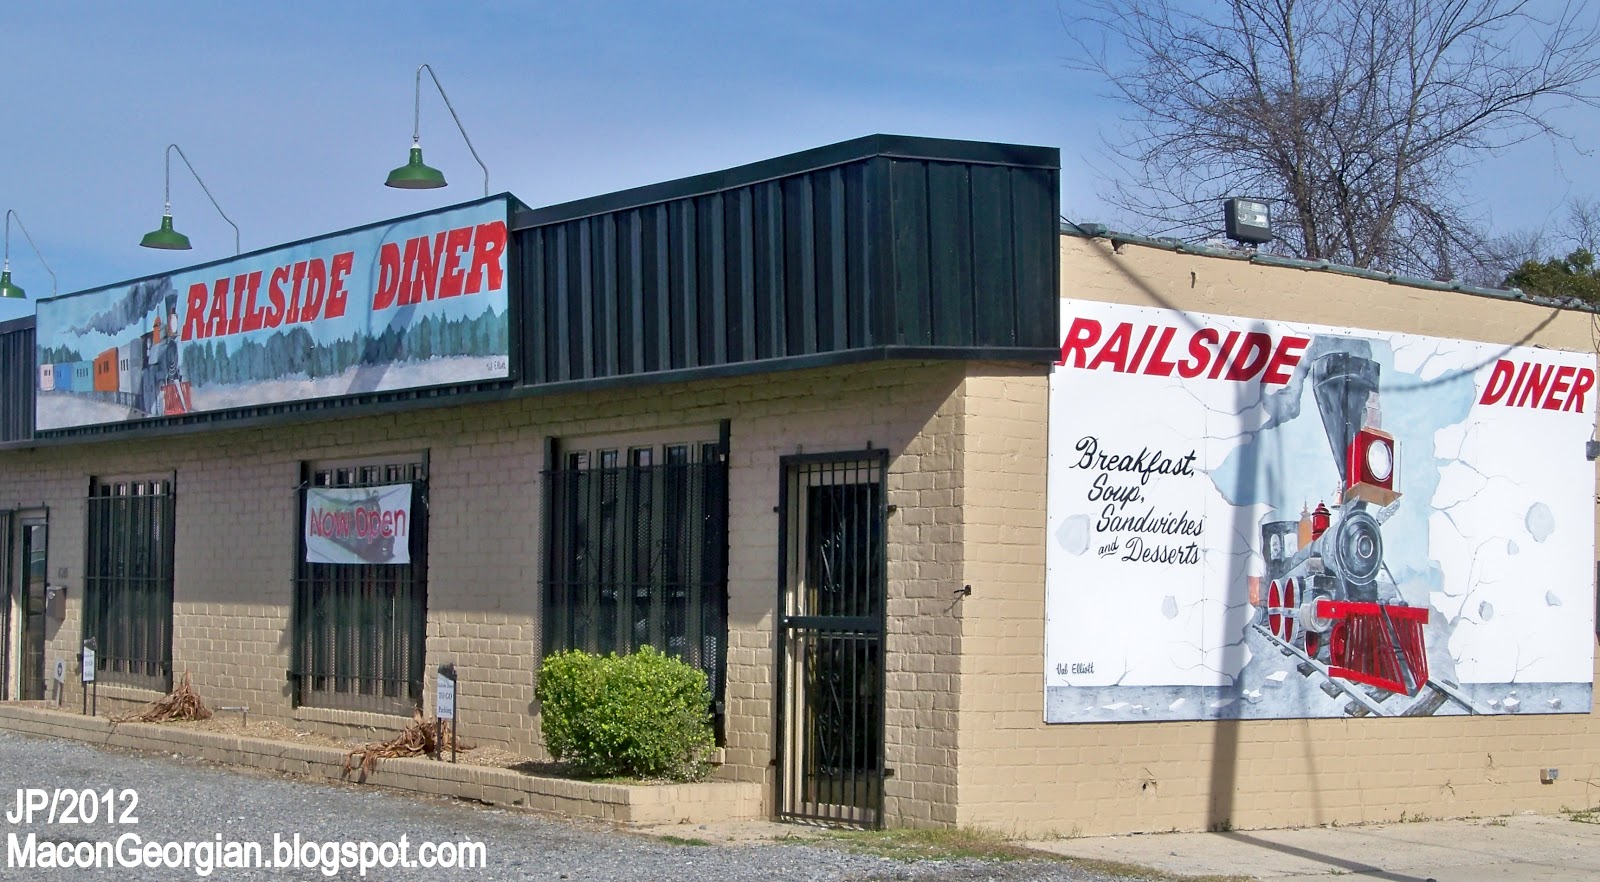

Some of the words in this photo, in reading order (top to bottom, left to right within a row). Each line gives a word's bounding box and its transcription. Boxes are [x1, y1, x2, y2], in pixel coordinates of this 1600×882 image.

[182, 253, 353, 340] RAILSIDE
[372, 220, 508, 310] DINER
[1056, 317, 1310, 385] RAILSIDE
[1480, 359, 1596, 413] DINER
[1069, 435, 1197, 485] Breakfast,
[1087, 472, 1145, 510] Soup,
[309, 507, 351, 538] Now
[355, 506, 406, 544] Open
[1096, 503, 1204, 537] Sandwiches
[1098, 536, 1119, 559] and
[1121, 536, 1200, 565] Desserts
